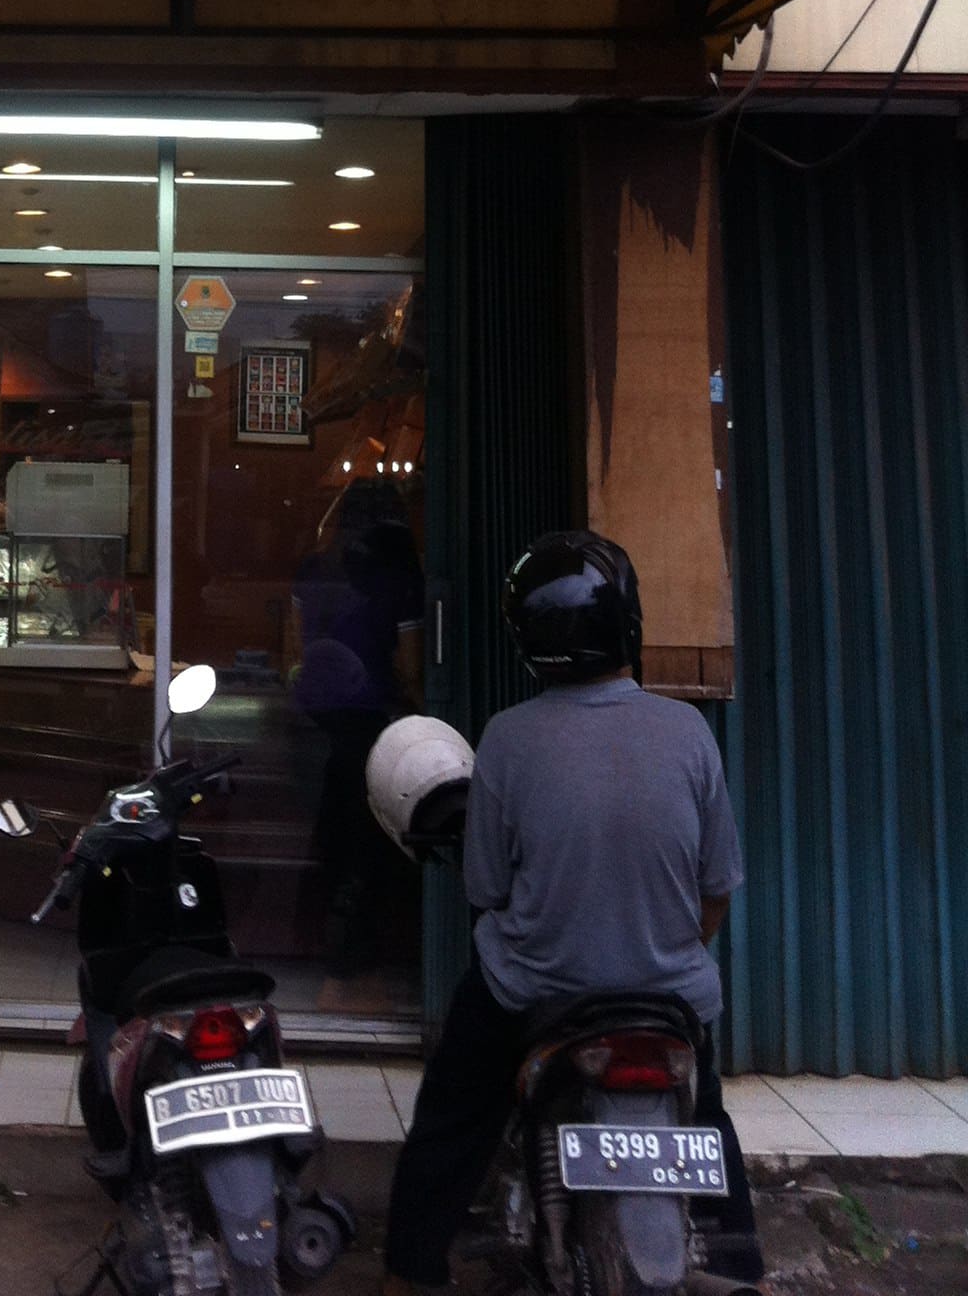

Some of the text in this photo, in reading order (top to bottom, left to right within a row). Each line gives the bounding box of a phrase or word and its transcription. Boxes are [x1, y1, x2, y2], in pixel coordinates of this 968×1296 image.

[565, 1131, 719, 1161] B 6399 THG
